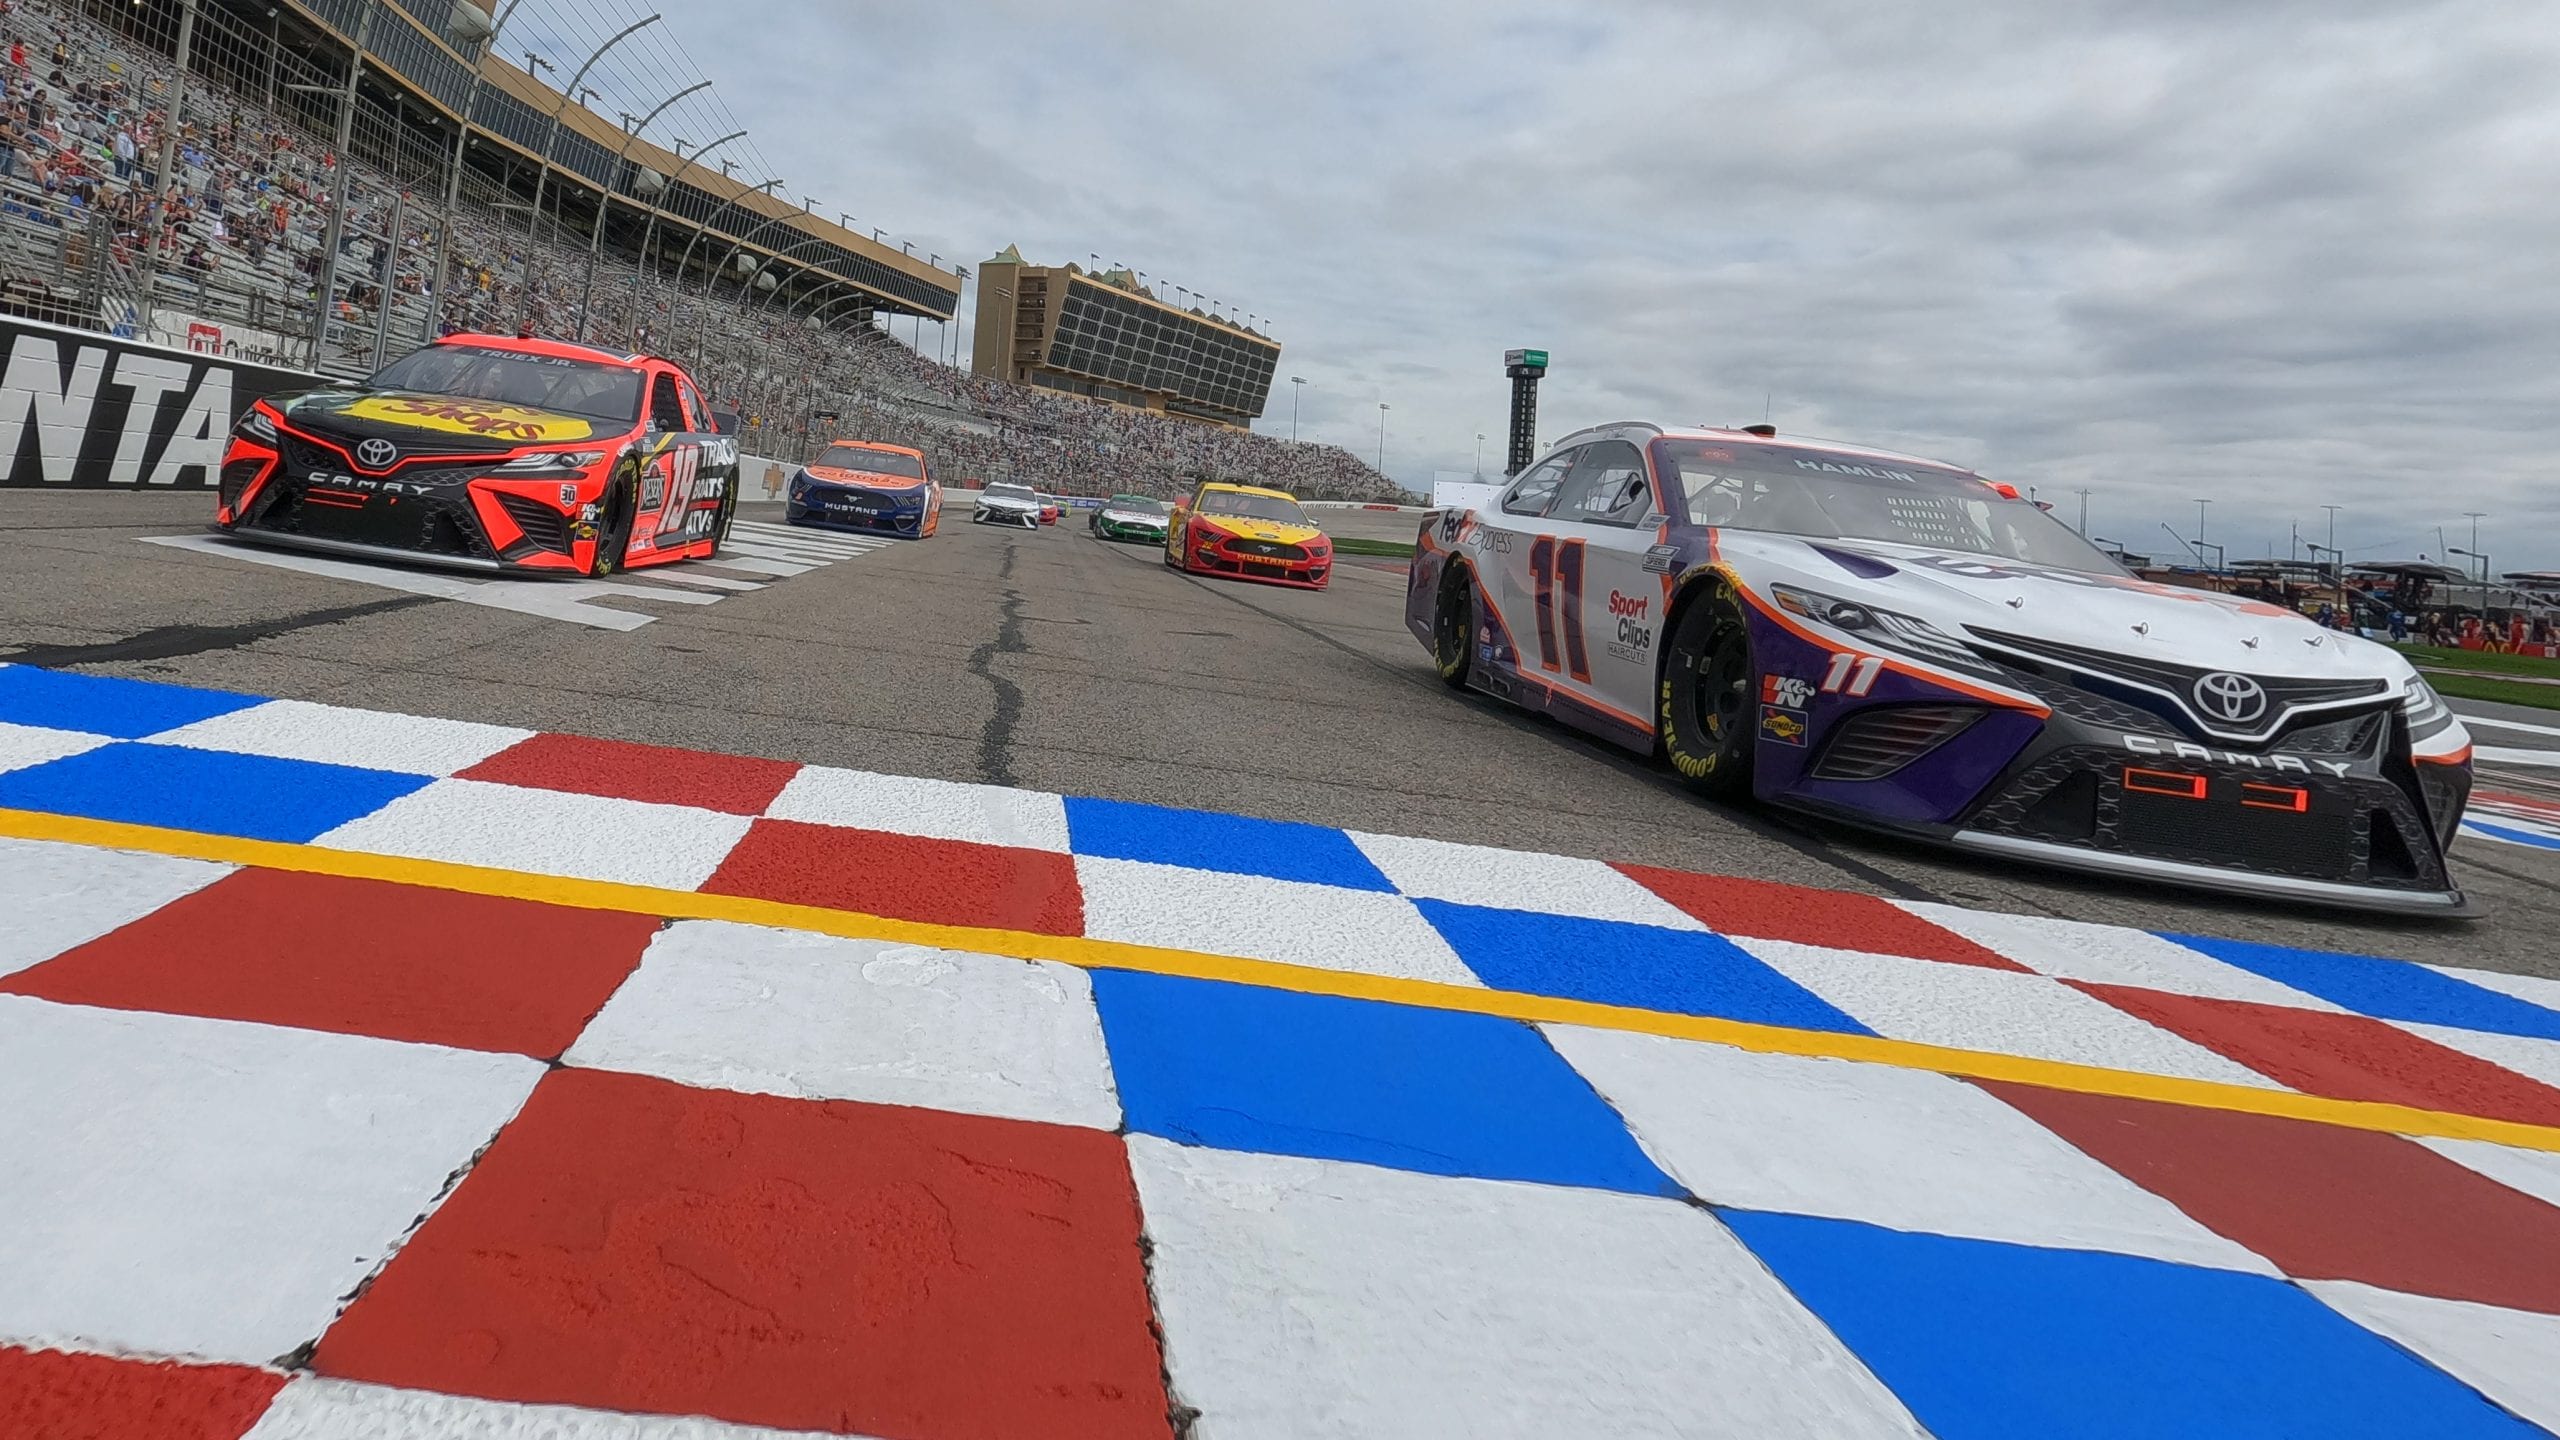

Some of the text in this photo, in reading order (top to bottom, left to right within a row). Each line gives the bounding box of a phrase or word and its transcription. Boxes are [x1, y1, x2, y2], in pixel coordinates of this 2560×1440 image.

[480, 350, 577, 369] TRUEX JR.
[381, 399, 546, 440] Shops
[308, 471, 434, 495] CAMRY
[1793, 458, 1916, 483] HAMLIN
[561, 488, 576, 501] 30
[657, 444, 698, 534] 19
[692, 476, 724, 500] BOATS
[685, 509, 714, 535] ATVs
[824, 502, 878, 516] MUSTANG
[1440, 509, 1514, 556] FedEx Express
[1237, 553, 1293, 567] MUSTANG
[1529, 534, 1593, 685] 11
[1608, 589, 1648, 621] Sport
[1617, 618, 1650, 649] Clips
[1608, 644, 1647, 663] HAIRCUTS
[1820, 652, 1885, 697] 11
[1661, 680, 1718, 778] GOODYEAR
[1763, 719, 1803, 734] SUNOCO
[2123, 734, 2352, 778] CAMRY
